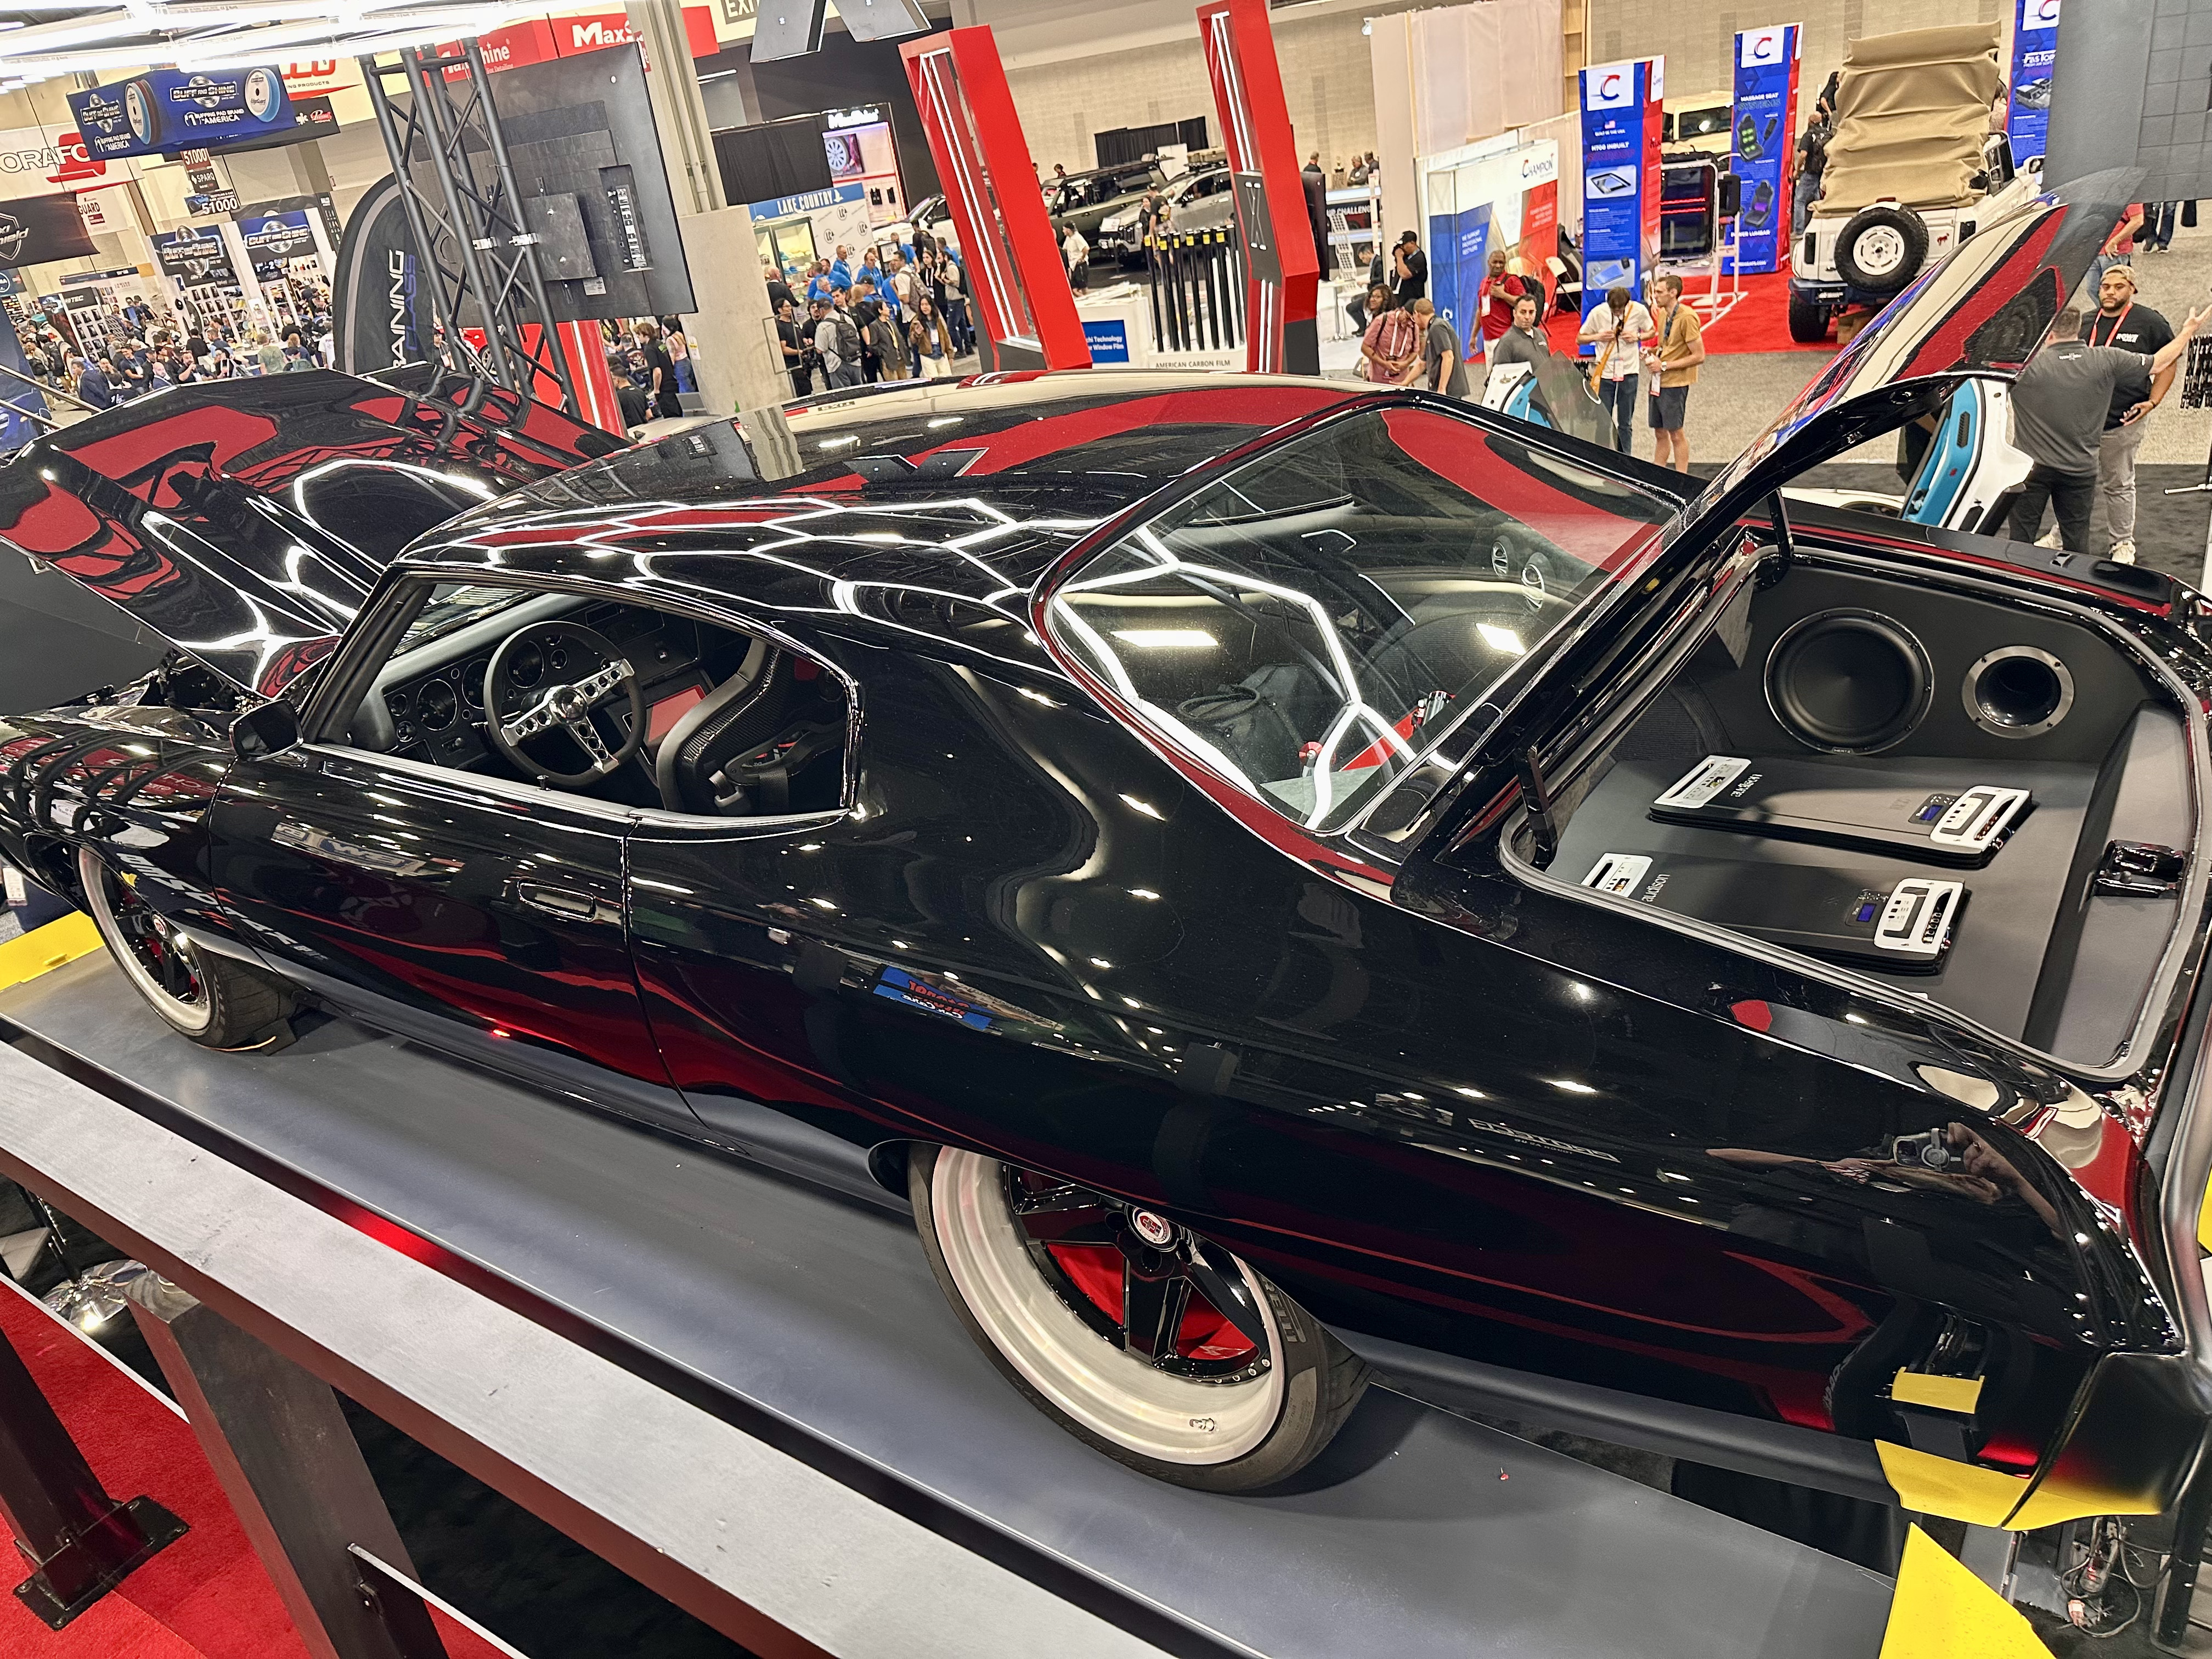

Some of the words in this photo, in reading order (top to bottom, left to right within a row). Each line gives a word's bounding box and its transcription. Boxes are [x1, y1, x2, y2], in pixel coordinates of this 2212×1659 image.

[727, 0, 759, 18] EXI
[204, 114, 240, 125] AMERICA
[77, 202, 100, 215] GUARD
[201, 198, 238, 215] 51000
[777, 198, 797, 215] LAKE
[798, 190, 833, 211] COUNTRY
[404, 254, 417, 351] CLASS
[1094, 335, 1123, 343] Technology
[1641, 873, 1671, 902] audison
